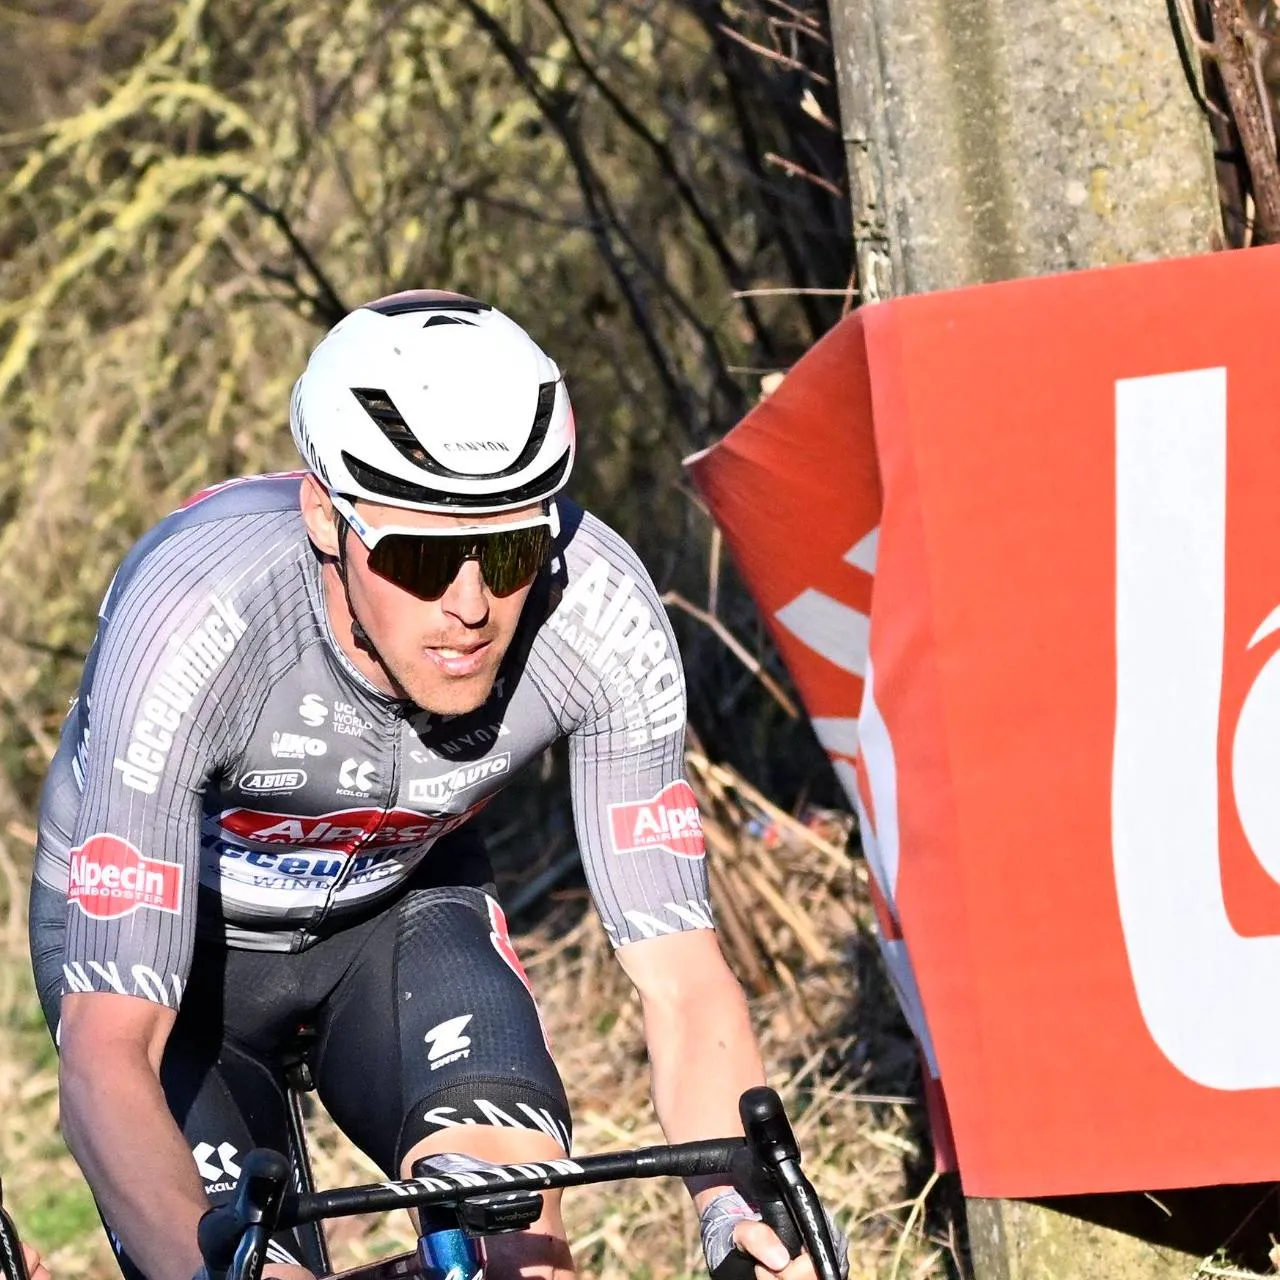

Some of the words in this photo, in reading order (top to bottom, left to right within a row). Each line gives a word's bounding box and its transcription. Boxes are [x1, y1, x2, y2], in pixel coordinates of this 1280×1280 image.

[443, 441, 510, 452] CANYON
[553, 557, 686, 742] Alpecin
[113, 594, 248, 794] deceuninck
[333, 700, 357, 716] UCI
[333, 710, 373, 731] WORLD
[332, 721, 365, 737] TEAM
[247, 772, 299, 789] ABUS
[633, 803, 704, 837] Alpe
[69, 855, 165, 896] Alpecin
[380, 1159, 585, 1197] CANYON
